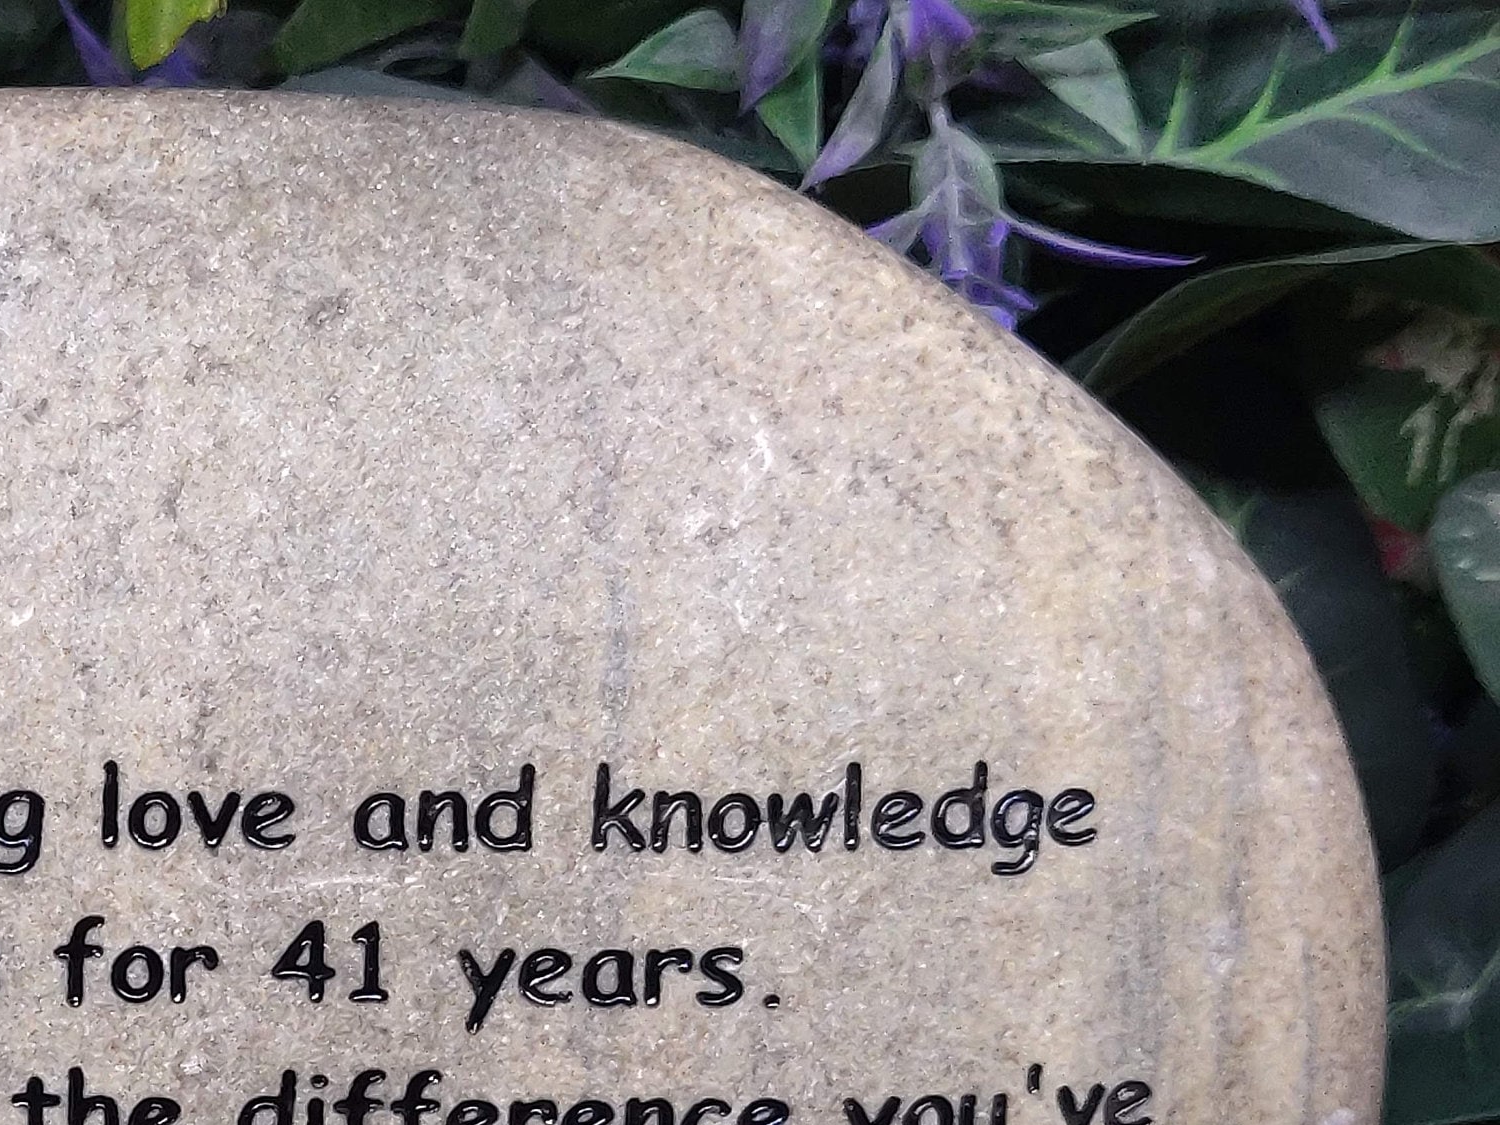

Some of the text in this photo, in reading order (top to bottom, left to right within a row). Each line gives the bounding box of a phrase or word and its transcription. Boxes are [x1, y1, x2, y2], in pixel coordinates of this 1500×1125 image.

[102, 760, 296, 851] love
[353, 763, 536, 853] and
[591, 761, 1097, 876] knowledge
[54, 915, 219, 1006] for
[271, 920, 389, 1004] 41
[458, 946, 781, 1032] years.
